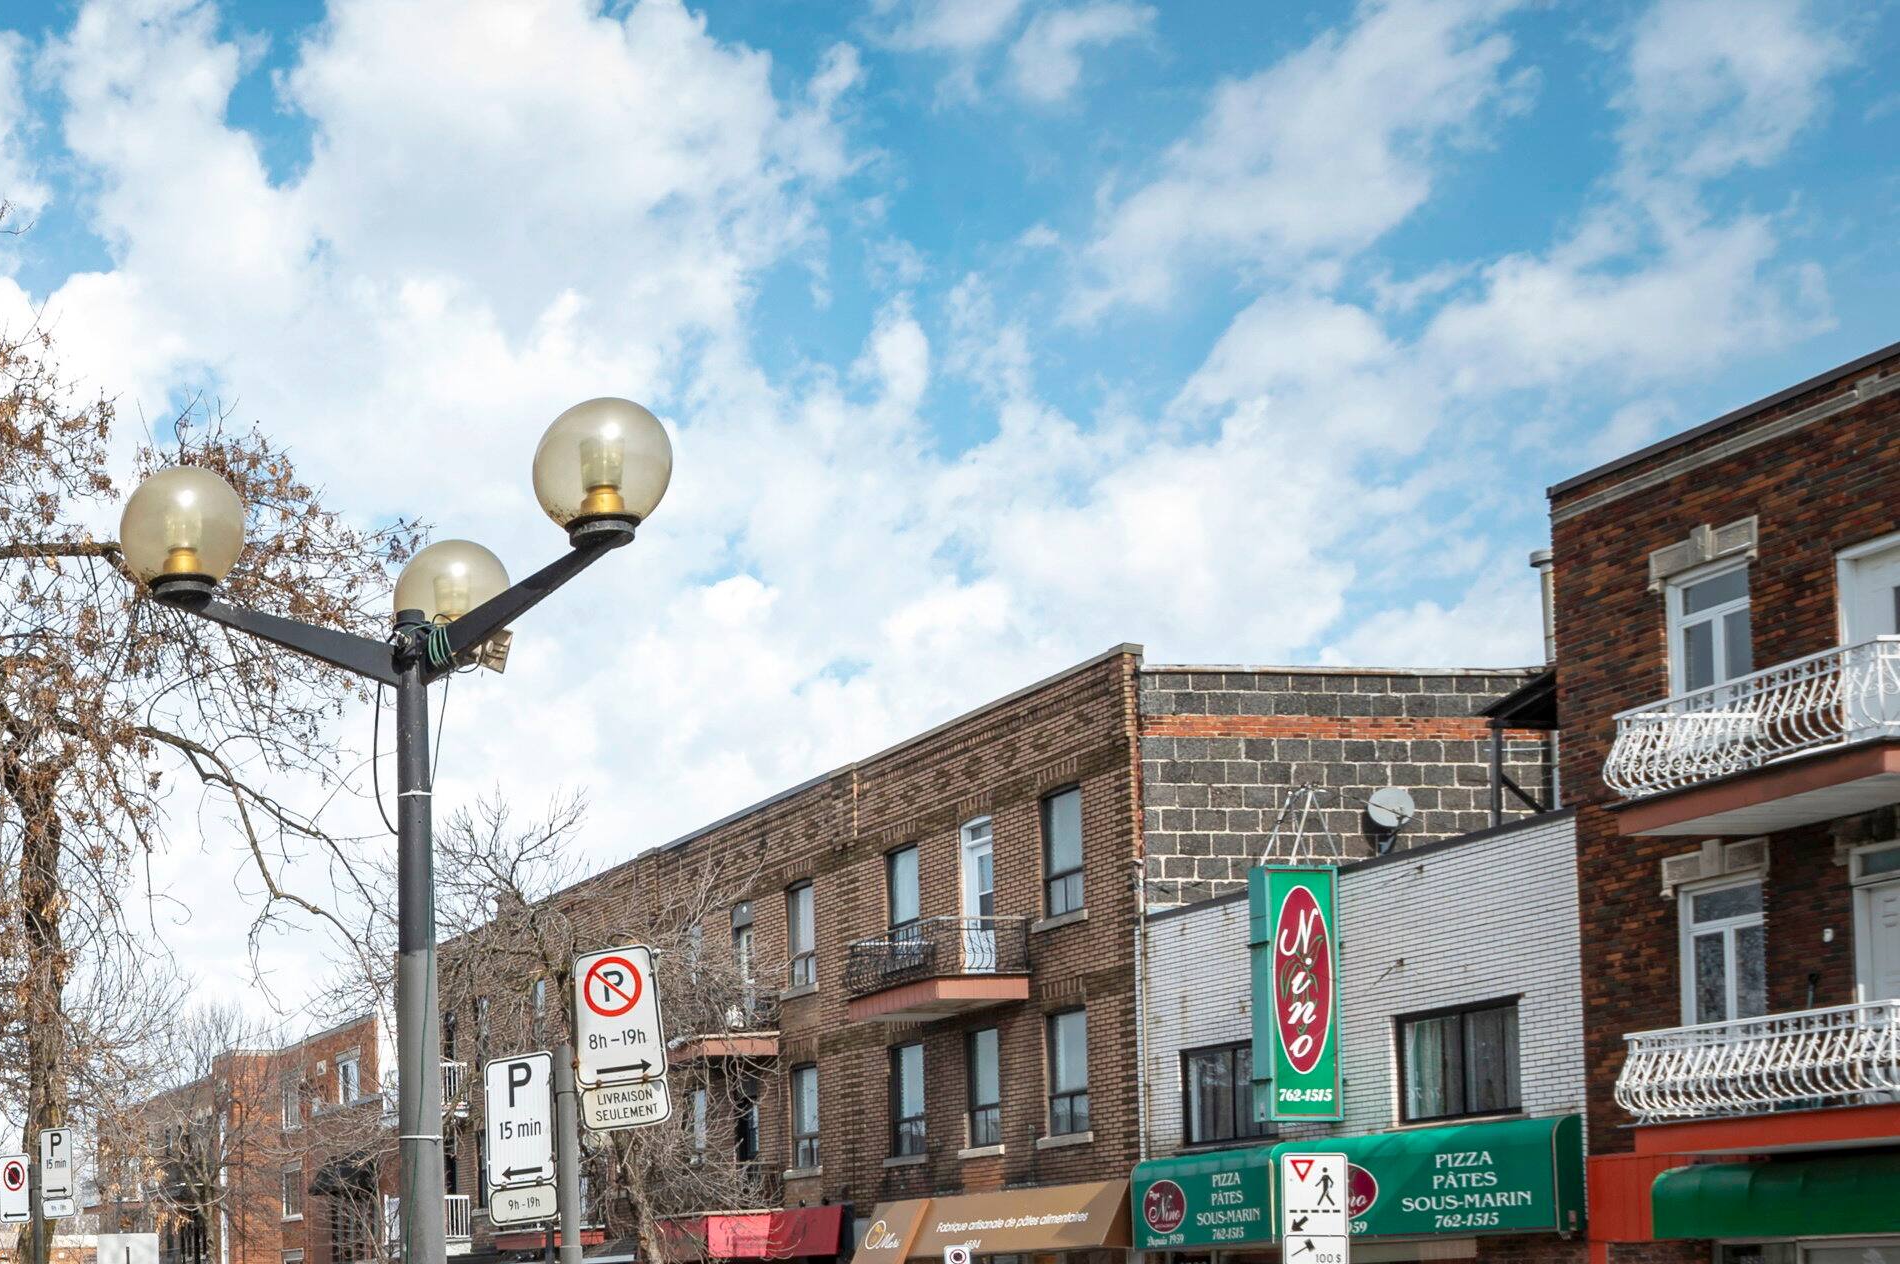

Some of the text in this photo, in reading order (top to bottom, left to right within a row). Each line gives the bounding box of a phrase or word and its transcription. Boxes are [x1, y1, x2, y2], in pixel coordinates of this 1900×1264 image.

[1279, 908, 1319, 1058] Nino
[508, 1062, 532, 1108] P
[597, 1088, 654, 1106] LIVRAISON
[1279, 1088, 1332, 1102] 762-1515
[595, 1104, 659, 1122] SEULEMENT
[499, 1119, 541, 1141] 15 min
[51, 1132, 62, 1157] P
[46, 1158, 67, 1169] 15 min
[1435, 1151, 1493, 1168] PIZZA
[1212, 1172, 1241, 1188] PIZZA
[1432, 1171, 1498, 1190] PÂTES
[1211, 1190, 1243, 1206] PÂTES
[1348, 1194, 1367, 1208] no
[1402, 1190, 1532, 1212] SOUS-MARIN
[1148, 1196, 1180, 1223] Nino
[1196, 1207, 1261, 1226] SOUS-MARIN
[936, 1222, 968, 1233] Fabrique
[968, 1218, 1005, 1230] artisanale
[1004, 1217, 1016, 1228] de
[1040, 1211, 1089, 1225] alimentaires
[1348, 1221, 1368, 1234] 59
[1434, 1212, 1499, 1229] 762-1515
[1169, 1233, 1185, 1245] 1959
[1212, 1226, 1244, 1240] 762-1515
[1316, 1253, 1342, 1264] 100 $
